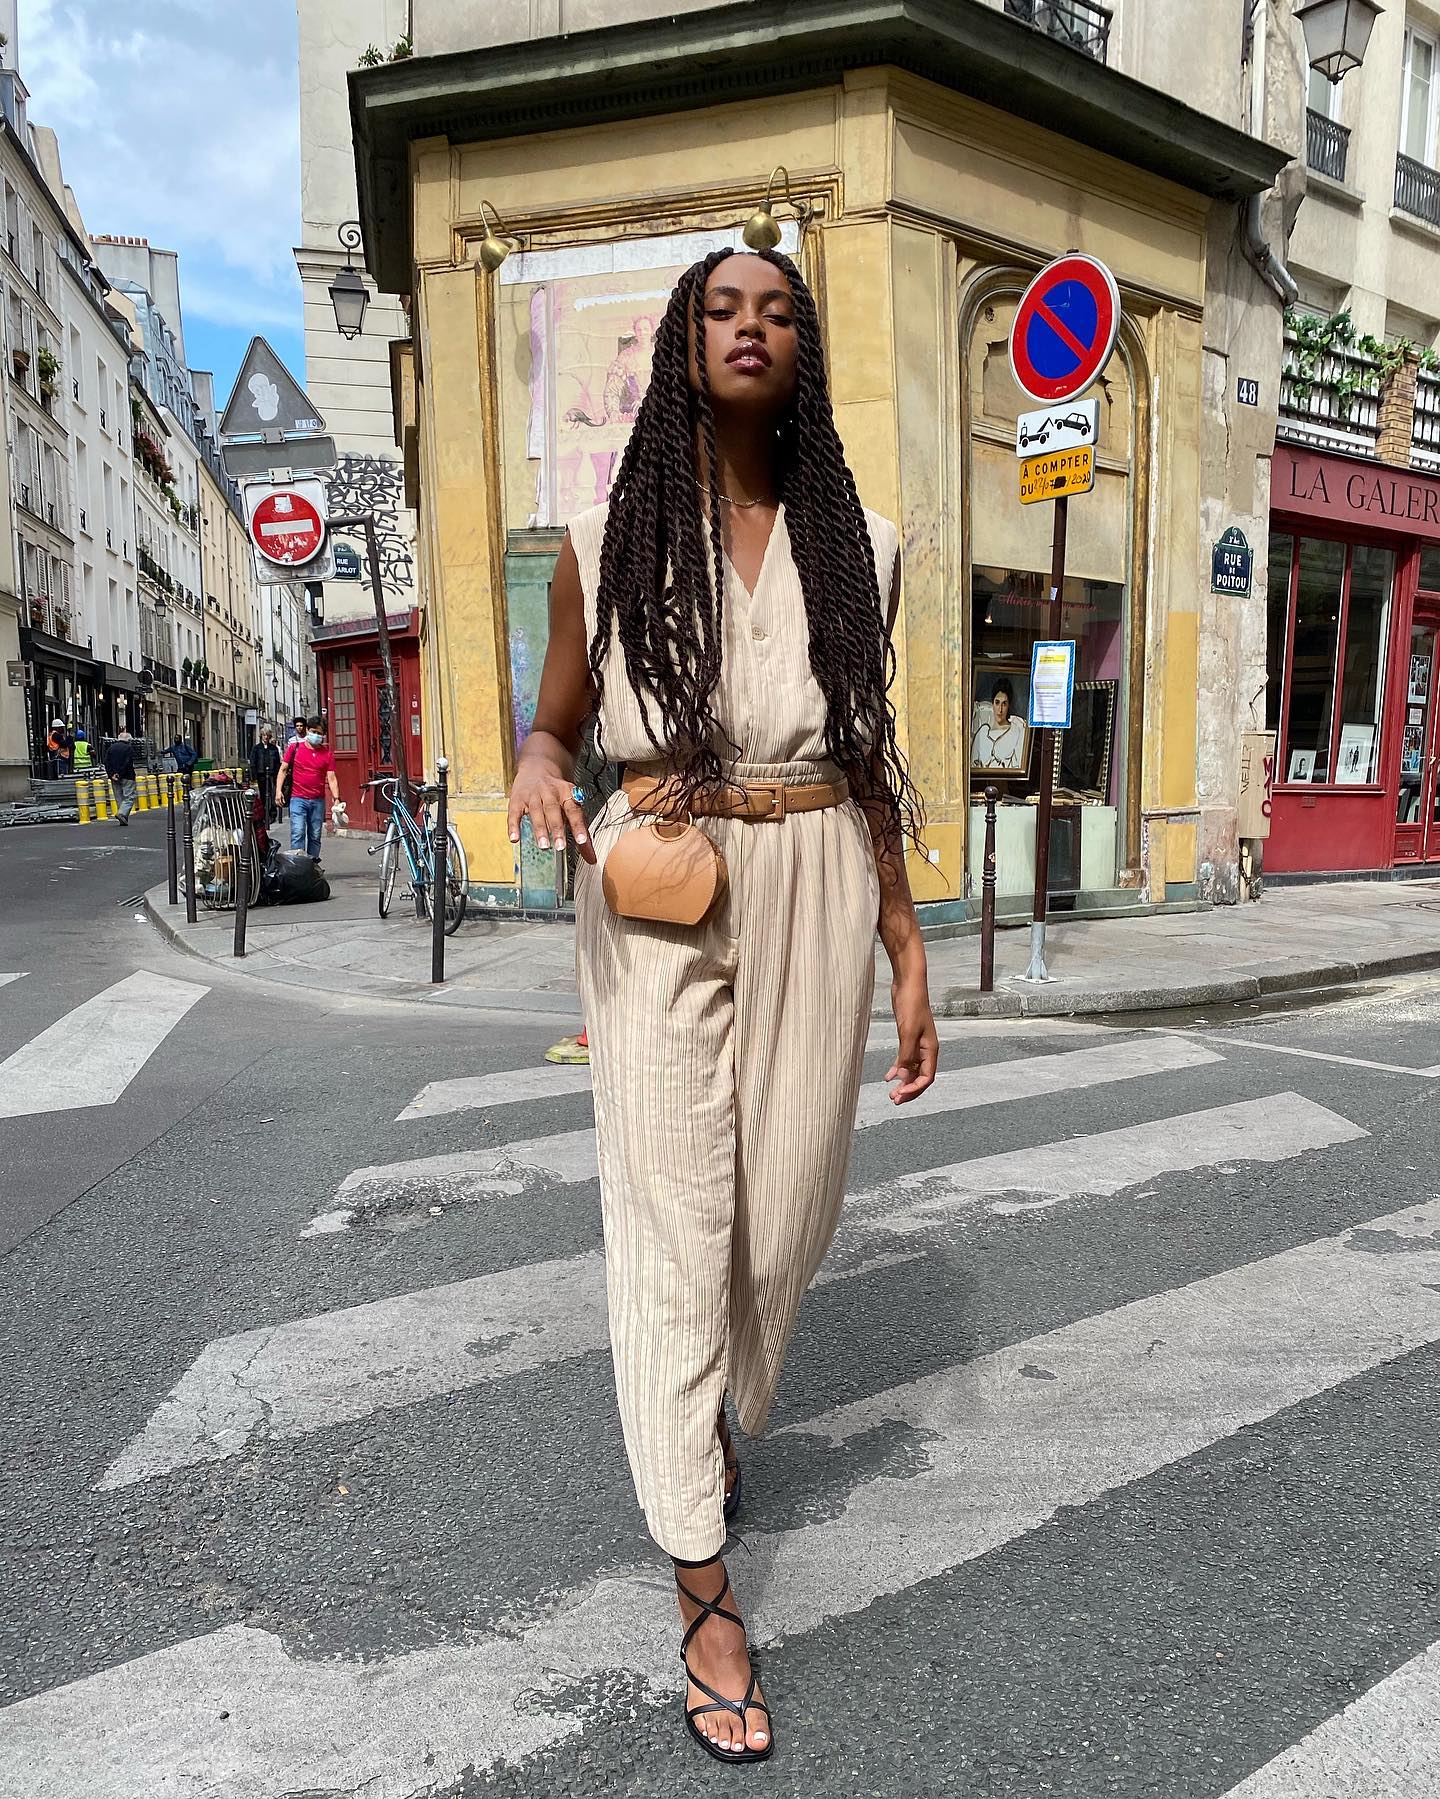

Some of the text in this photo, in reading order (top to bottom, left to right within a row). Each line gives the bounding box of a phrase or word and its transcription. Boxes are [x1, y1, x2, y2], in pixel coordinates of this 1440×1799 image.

[1239, 380, 1256, 404] 48
[1035, 453, 1089, 476] COMPTER
[1021, 483, 1034, 496] DU
[1289, 460, 1332, 504] LA
[1224, 552, 1242, 567] RUE
[1229, 566, 1236, 575] DE
[1216, 573, 1247, 589] POITOU
